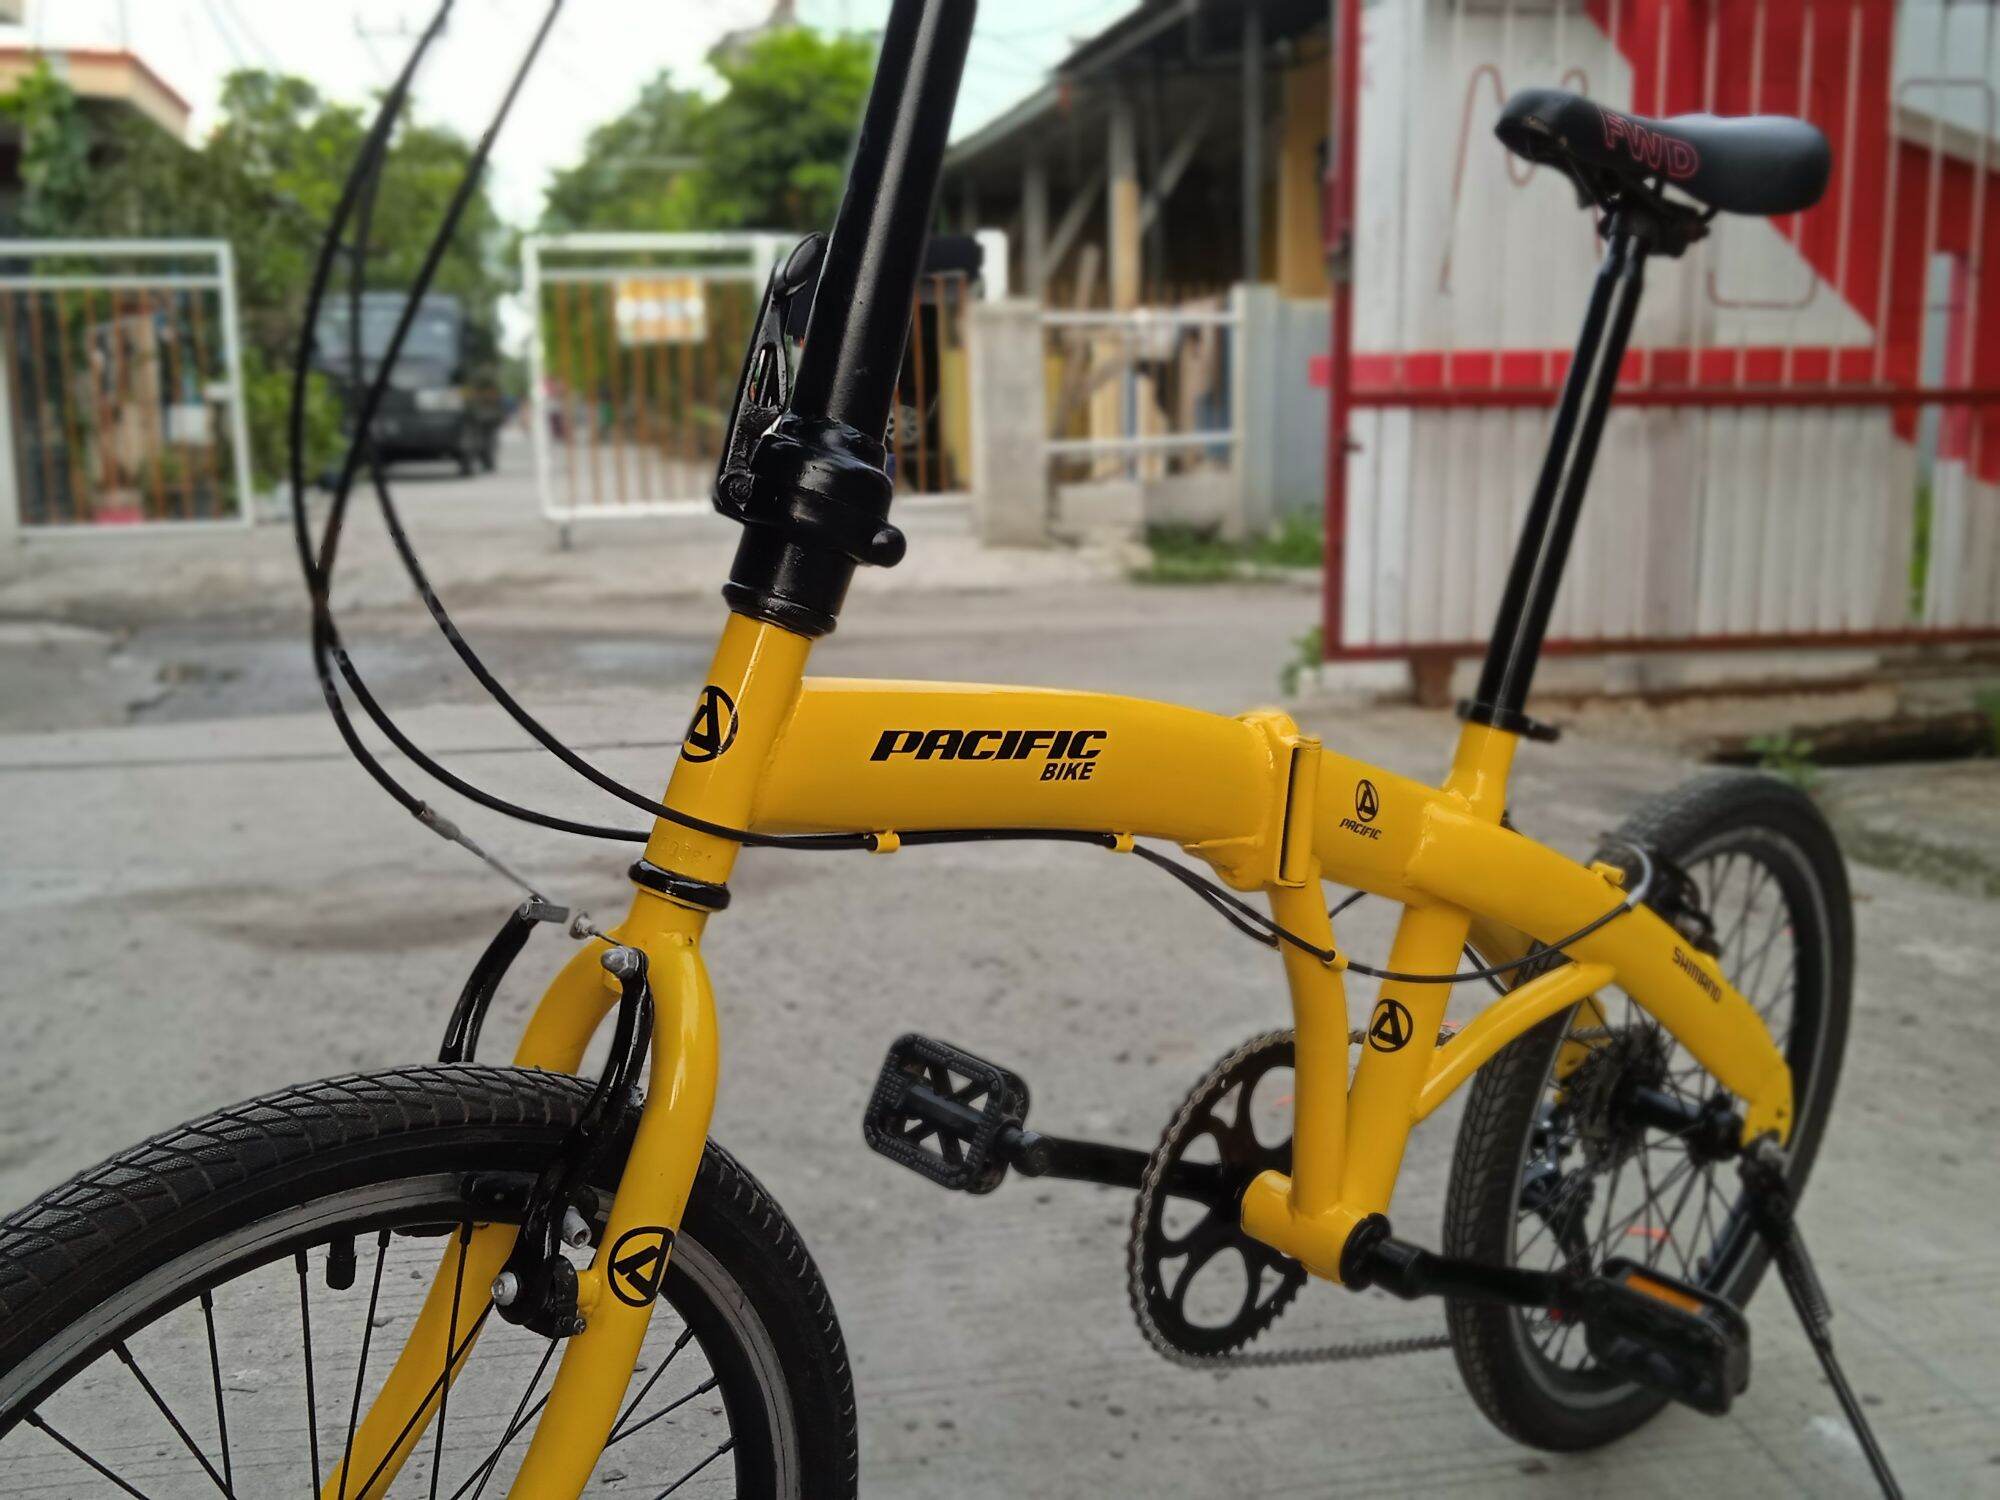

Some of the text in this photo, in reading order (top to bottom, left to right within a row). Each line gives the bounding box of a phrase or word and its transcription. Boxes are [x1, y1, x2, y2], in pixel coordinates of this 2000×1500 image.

[1601, 110, 1698, 177] FWD
[869, 729, 1108, 761] PACIFIC
[1039, 761, 1097, 781] BIKE
[1338, 817, 1382, 840] PACIFIC
[1671, 946, 1722, 1003] SHIMANO
